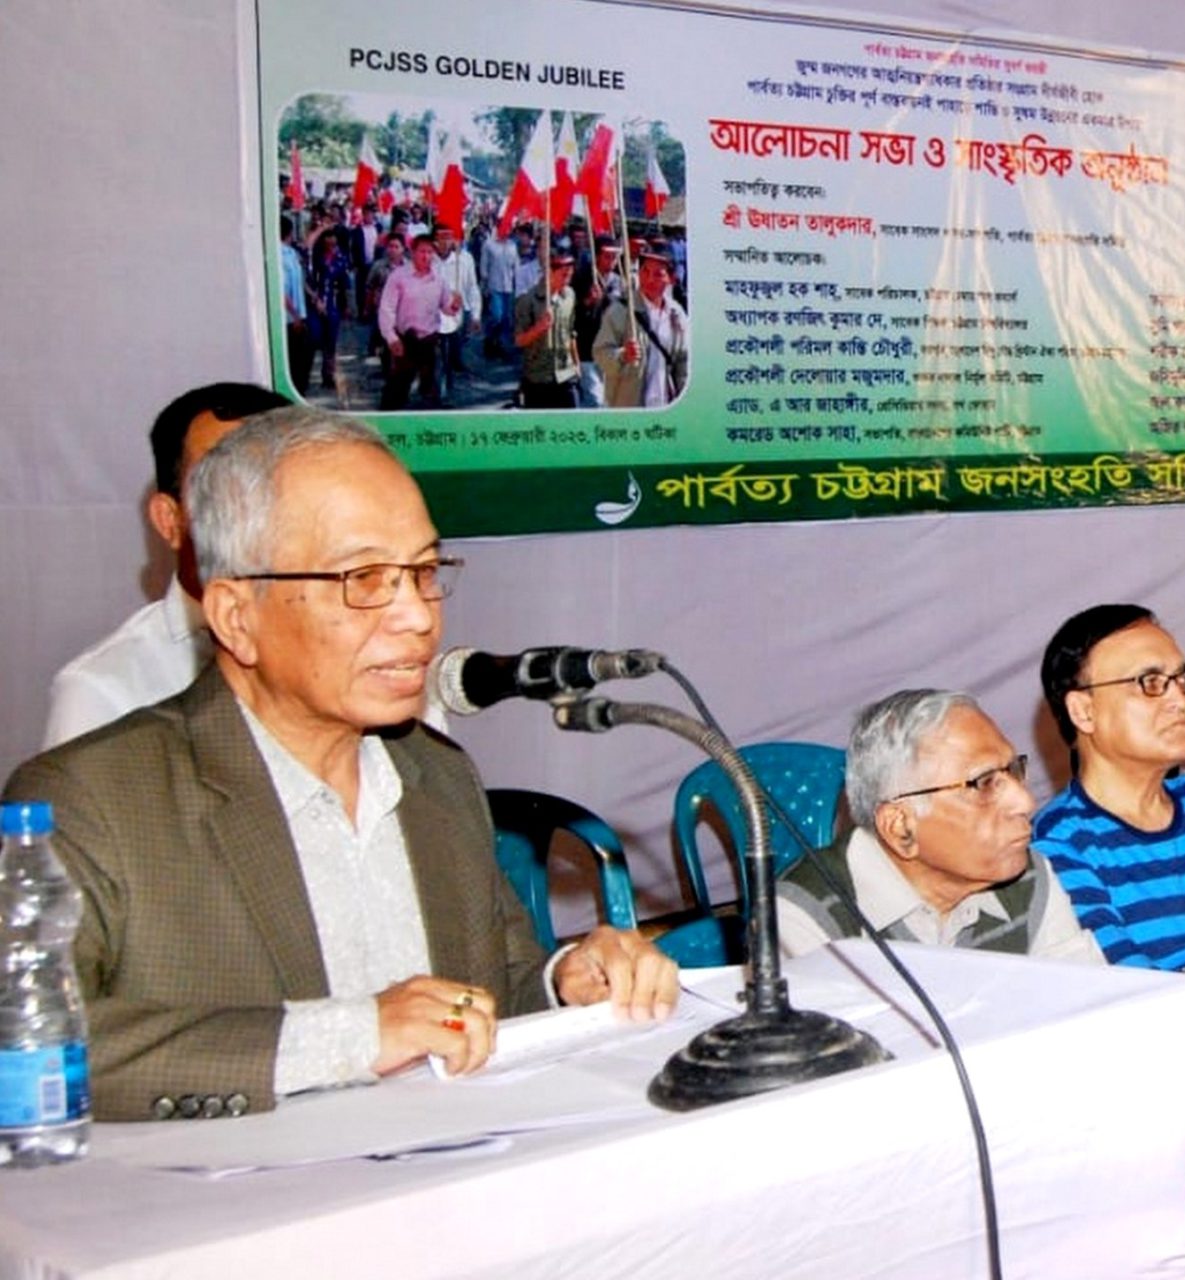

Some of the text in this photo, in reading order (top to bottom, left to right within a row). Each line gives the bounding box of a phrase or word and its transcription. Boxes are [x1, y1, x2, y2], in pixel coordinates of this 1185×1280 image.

[349, 47, 626, 91] PCJSS GOLDEN JUBILEE
[747, 76, 784, 97] পার্বত্য
[708, 118, 852, 162] আলোচনা
[859, 130, 916, 167] সভা
[923, 137, 947, 169] ও
[722, 203, 742, 230] শ্রী
[725, 280, 783, 301] মাহফুজুল
[788, 282, 809, 299] হক
[725, 309, 780, 328] অধ্যাপক
[829, 310, 863, 331] কুমার
[725, 333, 785, 356] প্রকৌশলী
[790, 334, 833, 356] পরিমল
[837, 335, 868, 357] কান্তি
[725, 363, 785, 386] প্রকৌশলী
[785, 396, 812, 413] আর
[725, 425, 775, 443] কমরেড
[779, 424, 823, 443] অশোক
[656, 464, 799, 508] পার্বত্য
[809, 462, 948, 502] চট্টগ্রাম
[956, 455, 1137, 497] জনসংহতি
